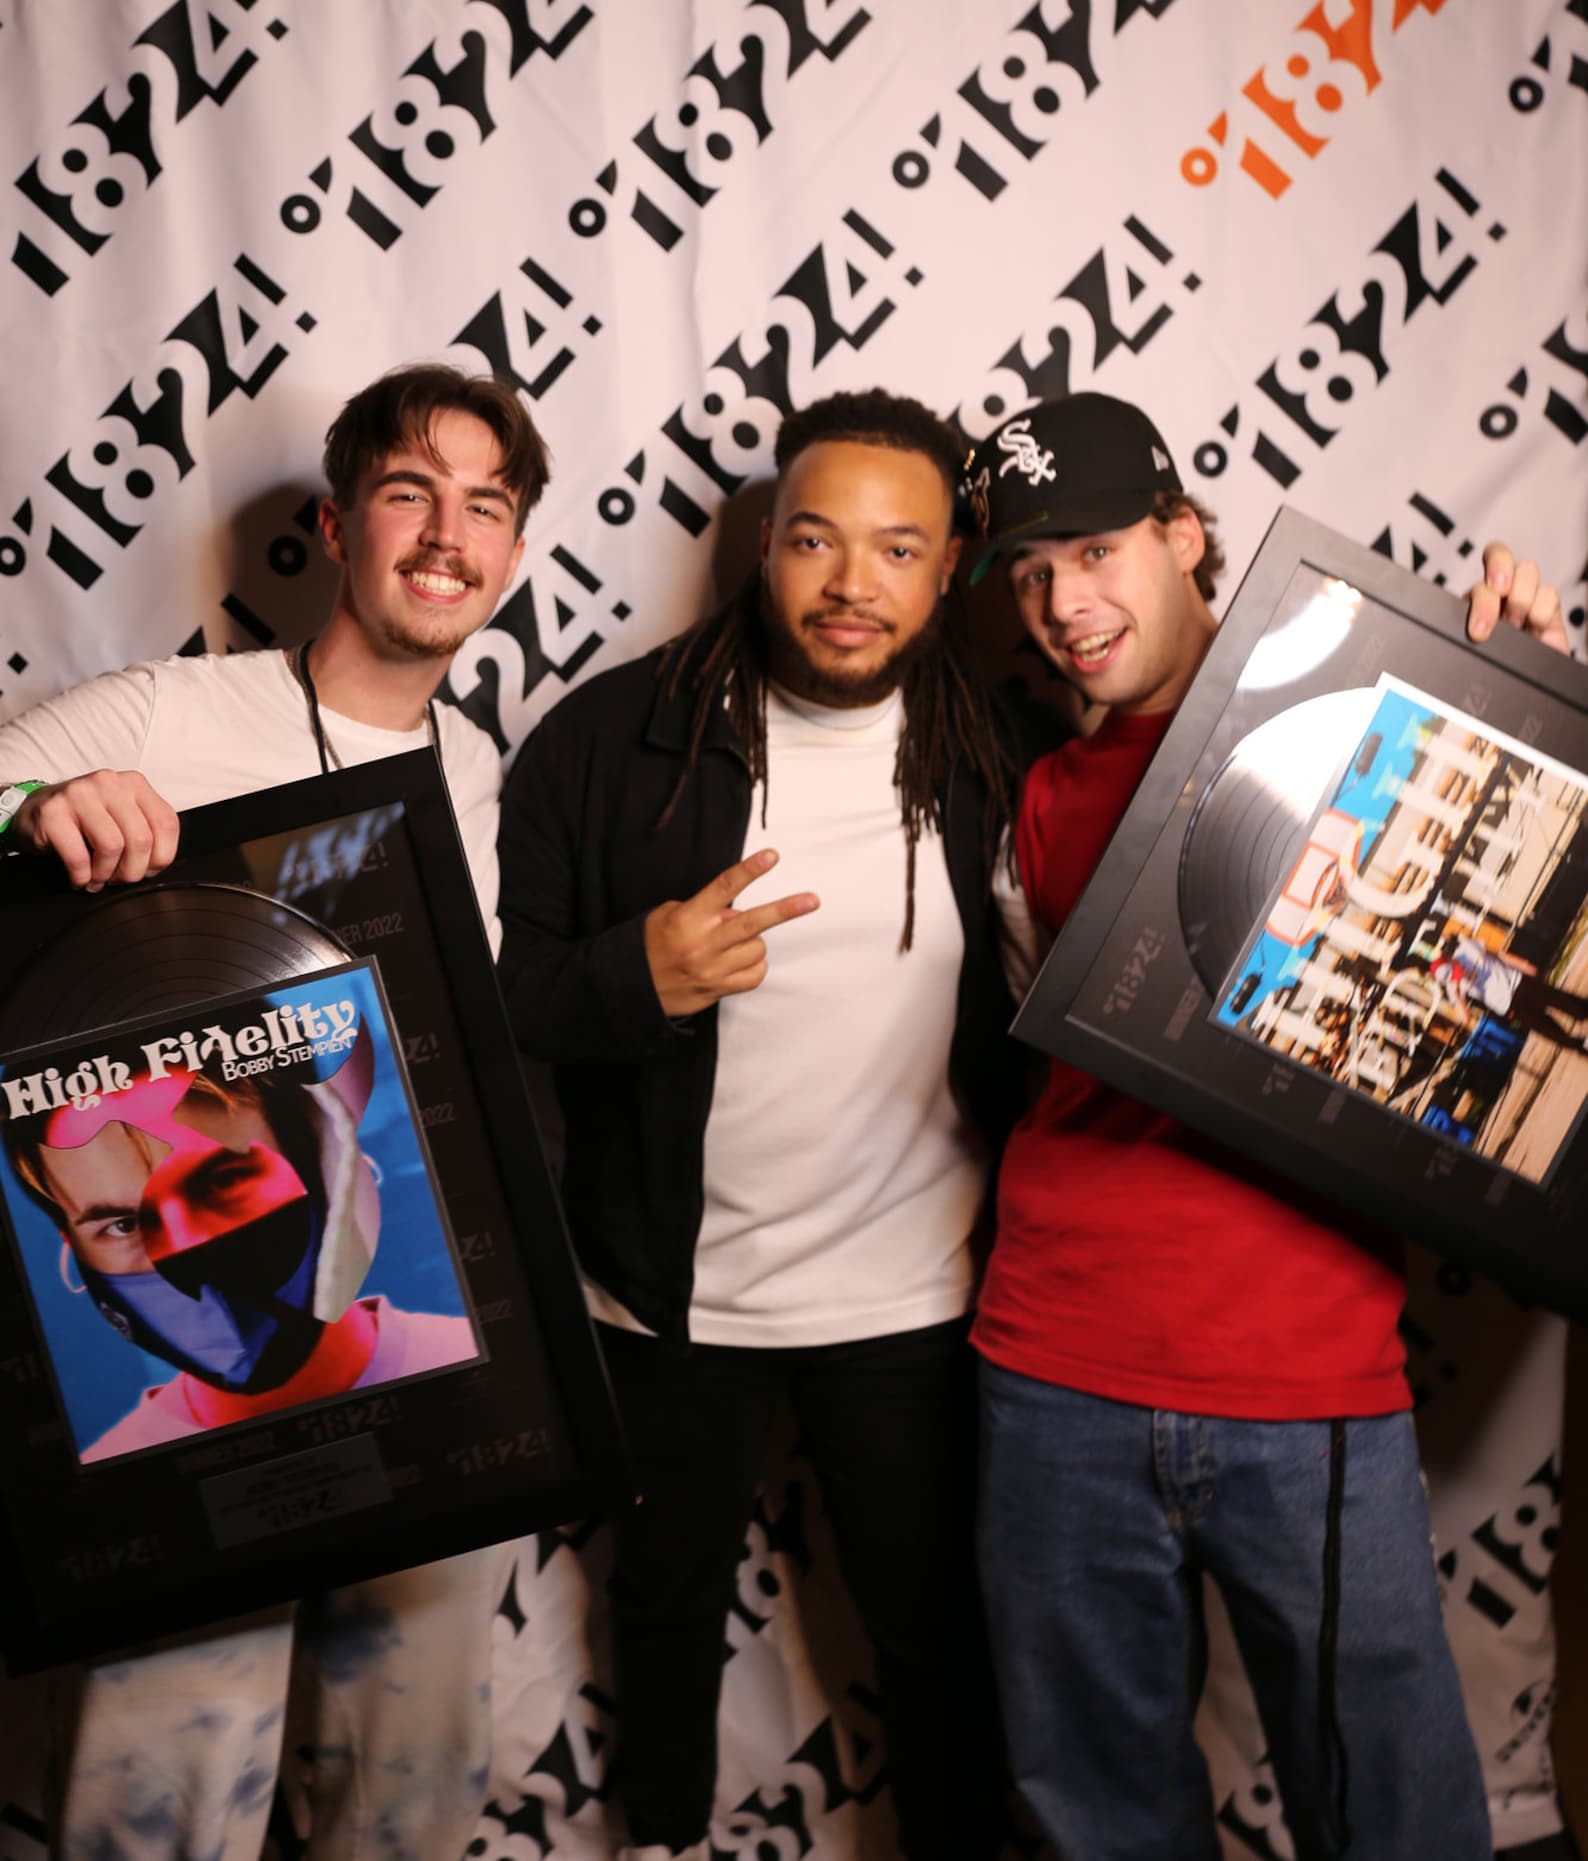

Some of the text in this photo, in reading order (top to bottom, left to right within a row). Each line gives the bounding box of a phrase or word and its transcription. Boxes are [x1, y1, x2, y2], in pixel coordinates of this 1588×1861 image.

[361, 911, 404, 940] 2022
[0, 1055, 134, 1119] High
[140, 1000, 358, 1083] Fidelity
